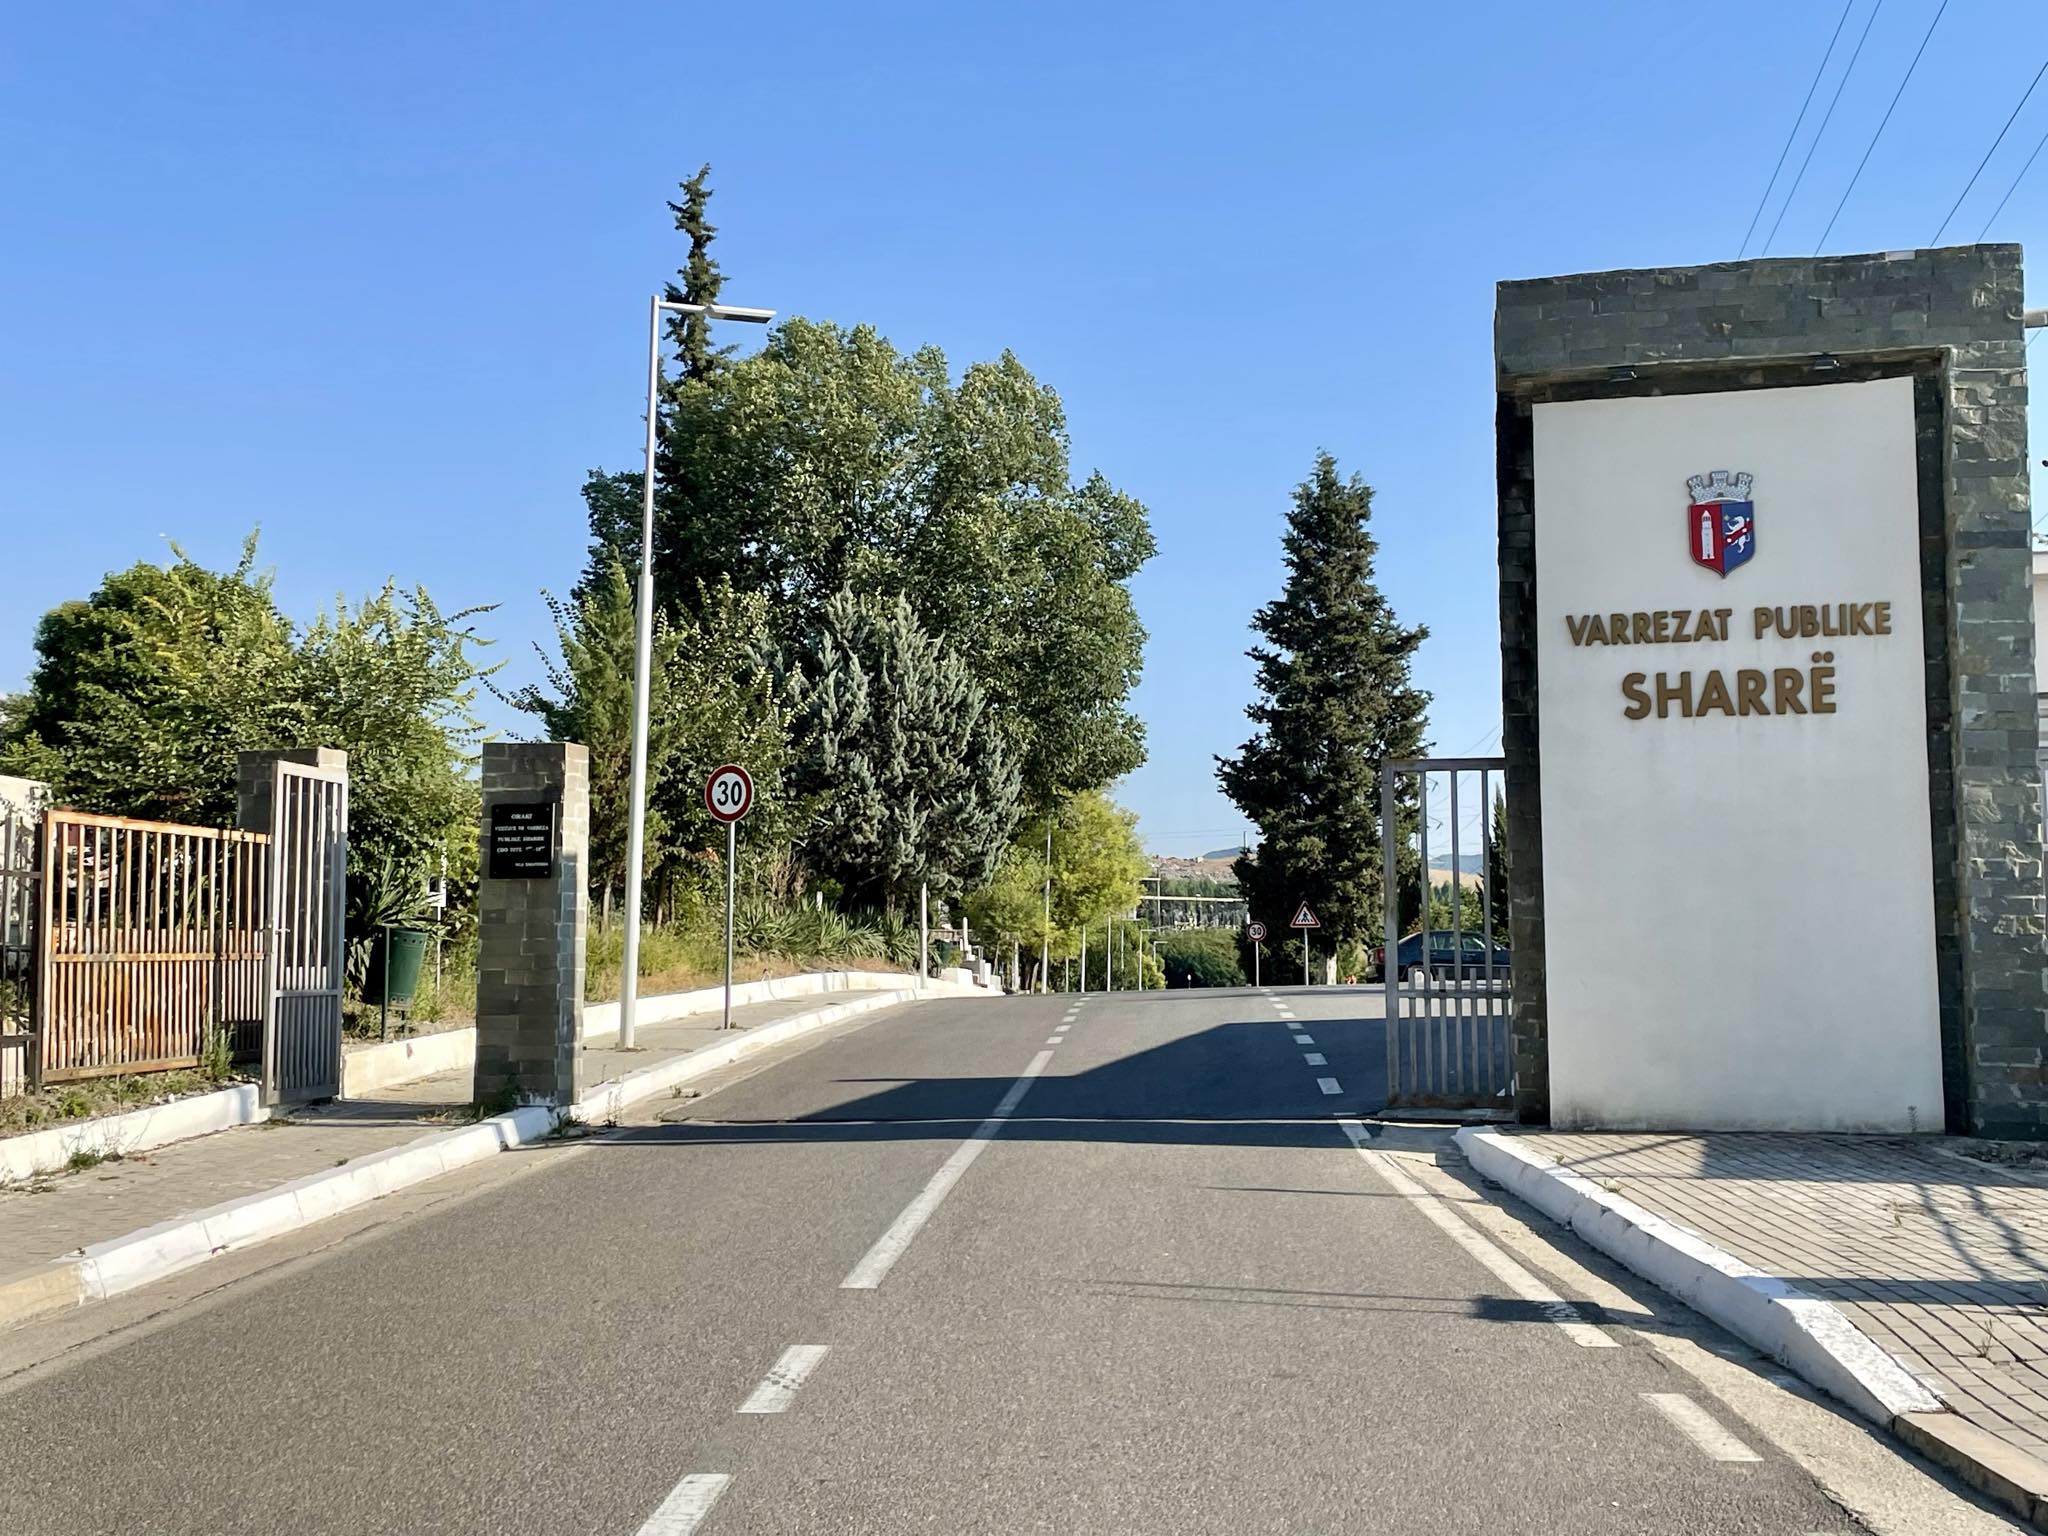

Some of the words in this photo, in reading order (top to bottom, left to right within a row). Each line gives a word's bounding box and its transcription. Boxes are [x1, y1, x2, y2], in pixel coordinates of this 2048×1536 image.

[1565, 608, 1733, 647] VARREZAT
[1754, 601, 1892, 640] PUBLIKE
[1621, 651, 1837, 720] SHARRË
[717, 780, 742, 806] 30
[1251, 926, 1262, 936] 30
